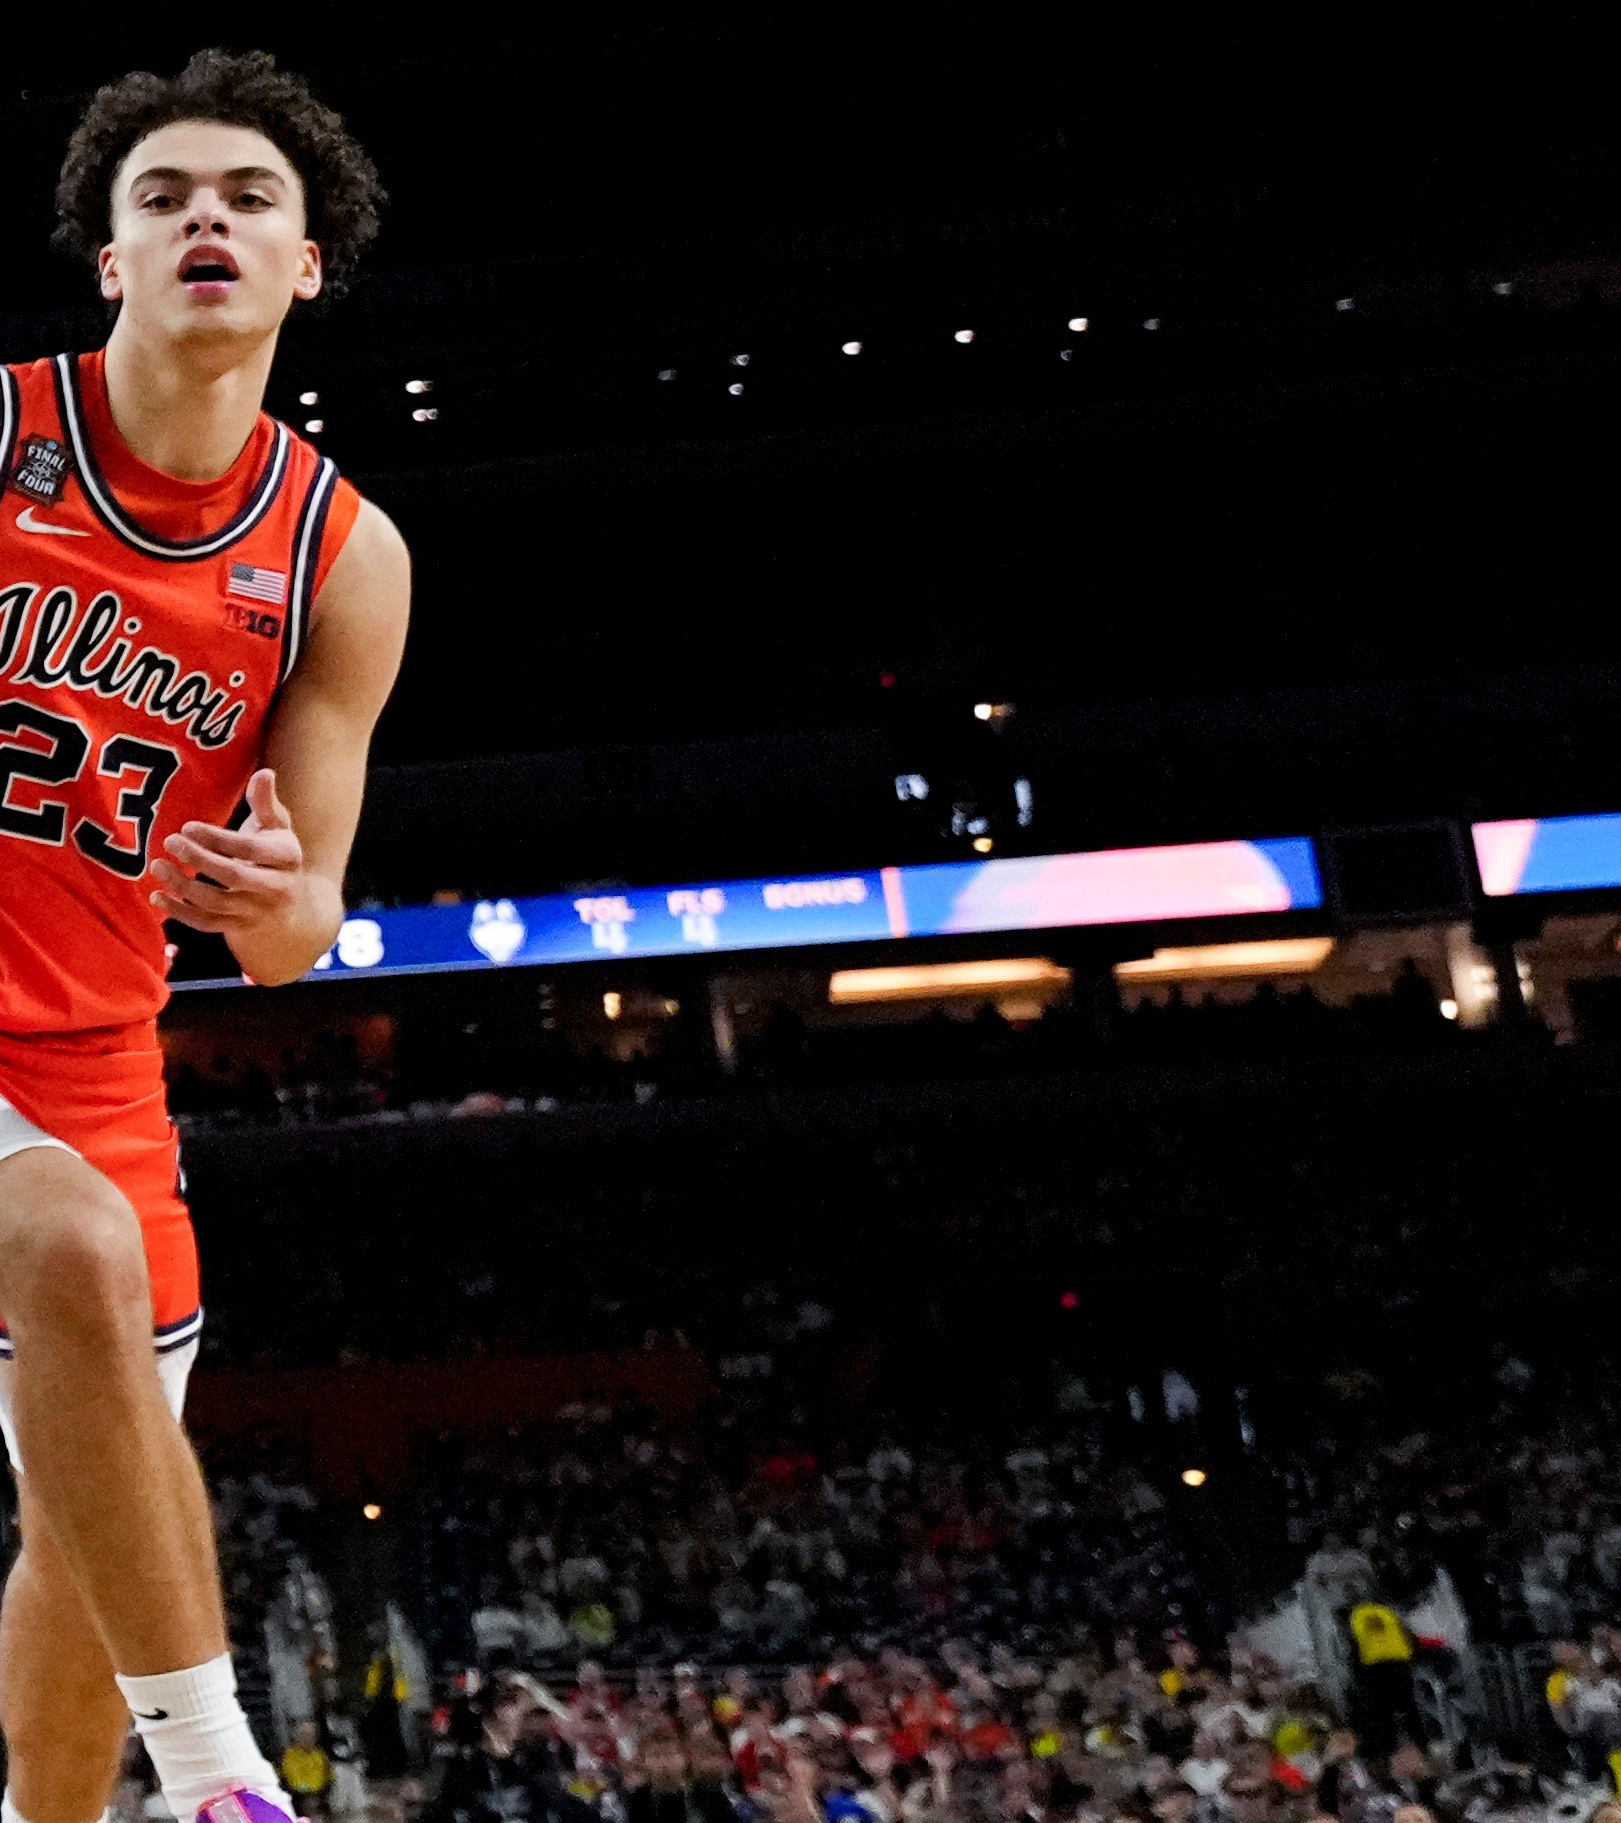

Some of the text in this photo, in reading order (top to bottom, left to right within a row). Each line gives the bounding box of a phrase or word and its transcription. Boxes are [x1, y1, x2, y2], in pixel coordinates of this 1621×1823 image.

[27, 445, 67, 472] FINAL
[17, 469, 56, 496] FOUR
[762, 877, 867, 909] BONUS
